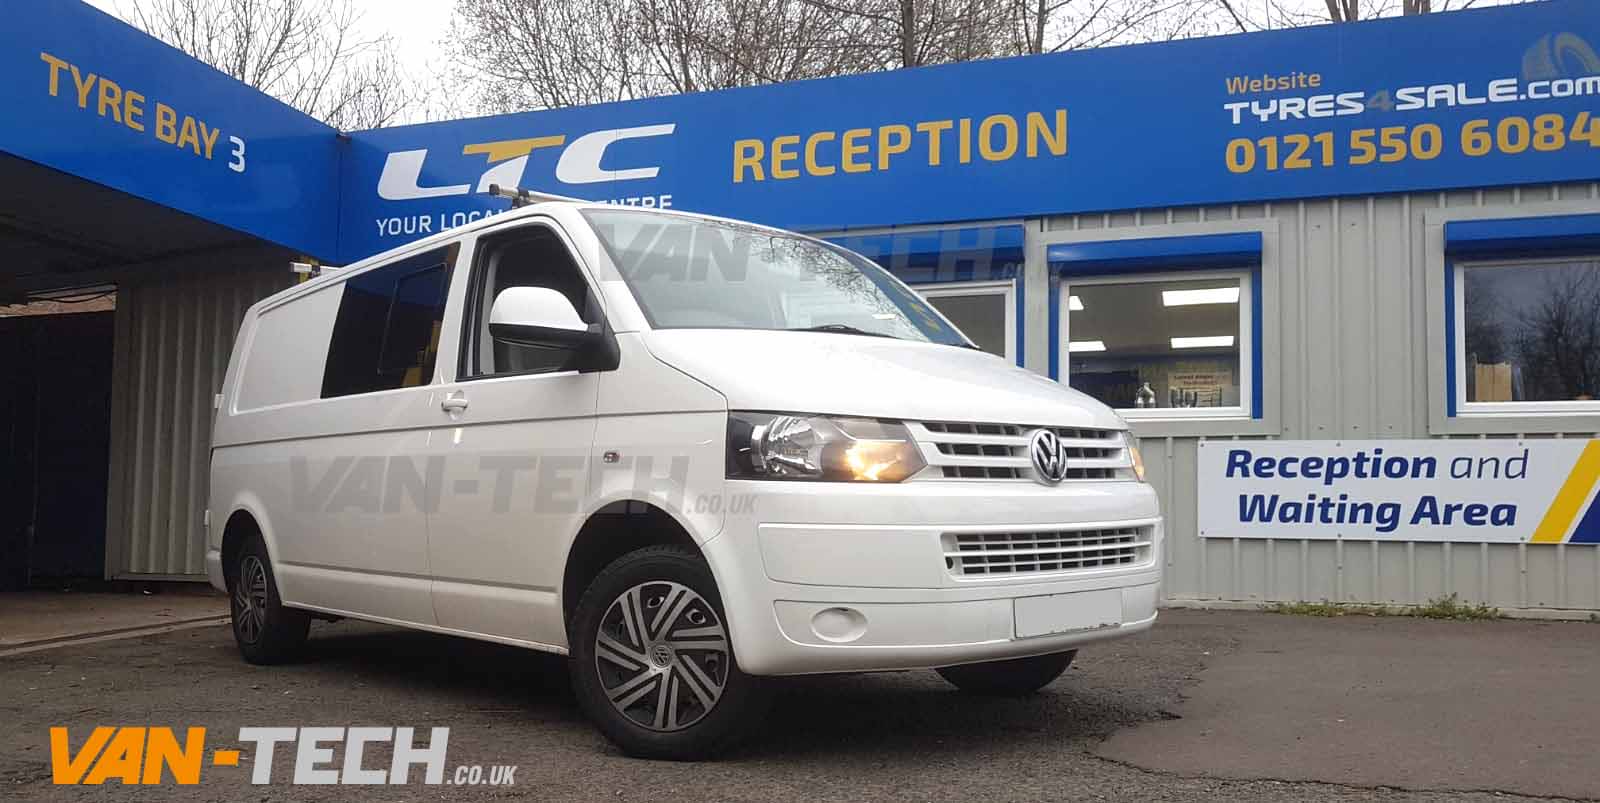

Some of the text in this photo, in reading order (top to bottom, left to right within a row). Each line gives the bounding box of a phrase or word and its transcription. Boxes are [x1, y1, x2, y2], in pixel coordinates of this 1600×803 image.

[1226, 71, 1321, 95] Website
[40, 52, 246, 173] TYRE BAY 3
[377, 123, 676, 200] LTC
[733, 109, 1067, 183] RECEPTION
[1225, 111, 1600, 173] 0121 550 6084
[376, 209, 504, 236] YOUR LOC
[1226, 448, 1530, 485] Reception and
[1238, 494, 1518, 532] Waiting Area
